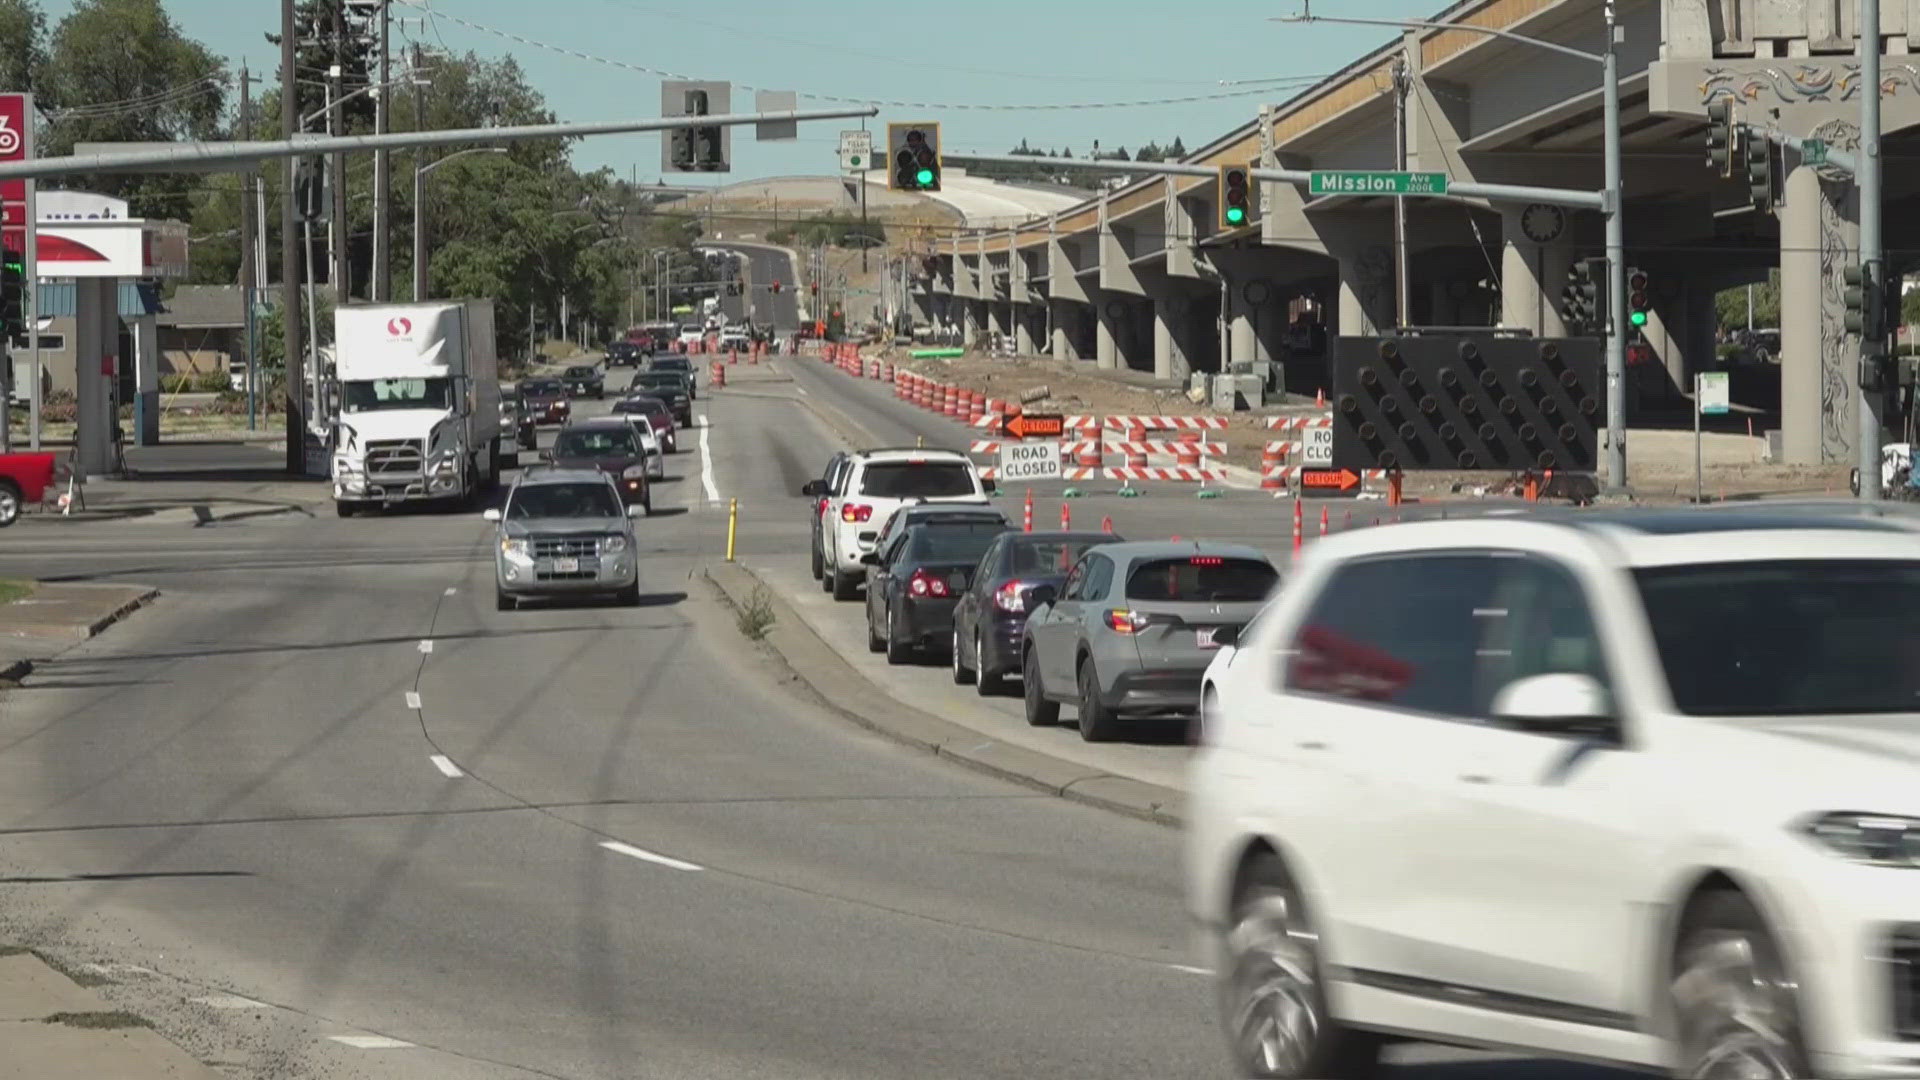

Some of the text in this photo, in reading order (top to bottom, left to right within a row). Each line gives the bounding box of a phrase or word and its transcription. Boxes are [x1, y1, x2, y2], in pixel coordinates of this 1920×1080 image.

[1322, 173, 1430, 191] Mission Ave
[1405, 183, 1434, 192] 3200E
[1021, 420, 1058, 431] DETOUR
[1314, 431, 1332, 443] RO
[1012, 446, 1048, 460] ROAD
[1307, 446, 1332, 459] CLO
[1006, 461, 1056, 477] CLOSED
